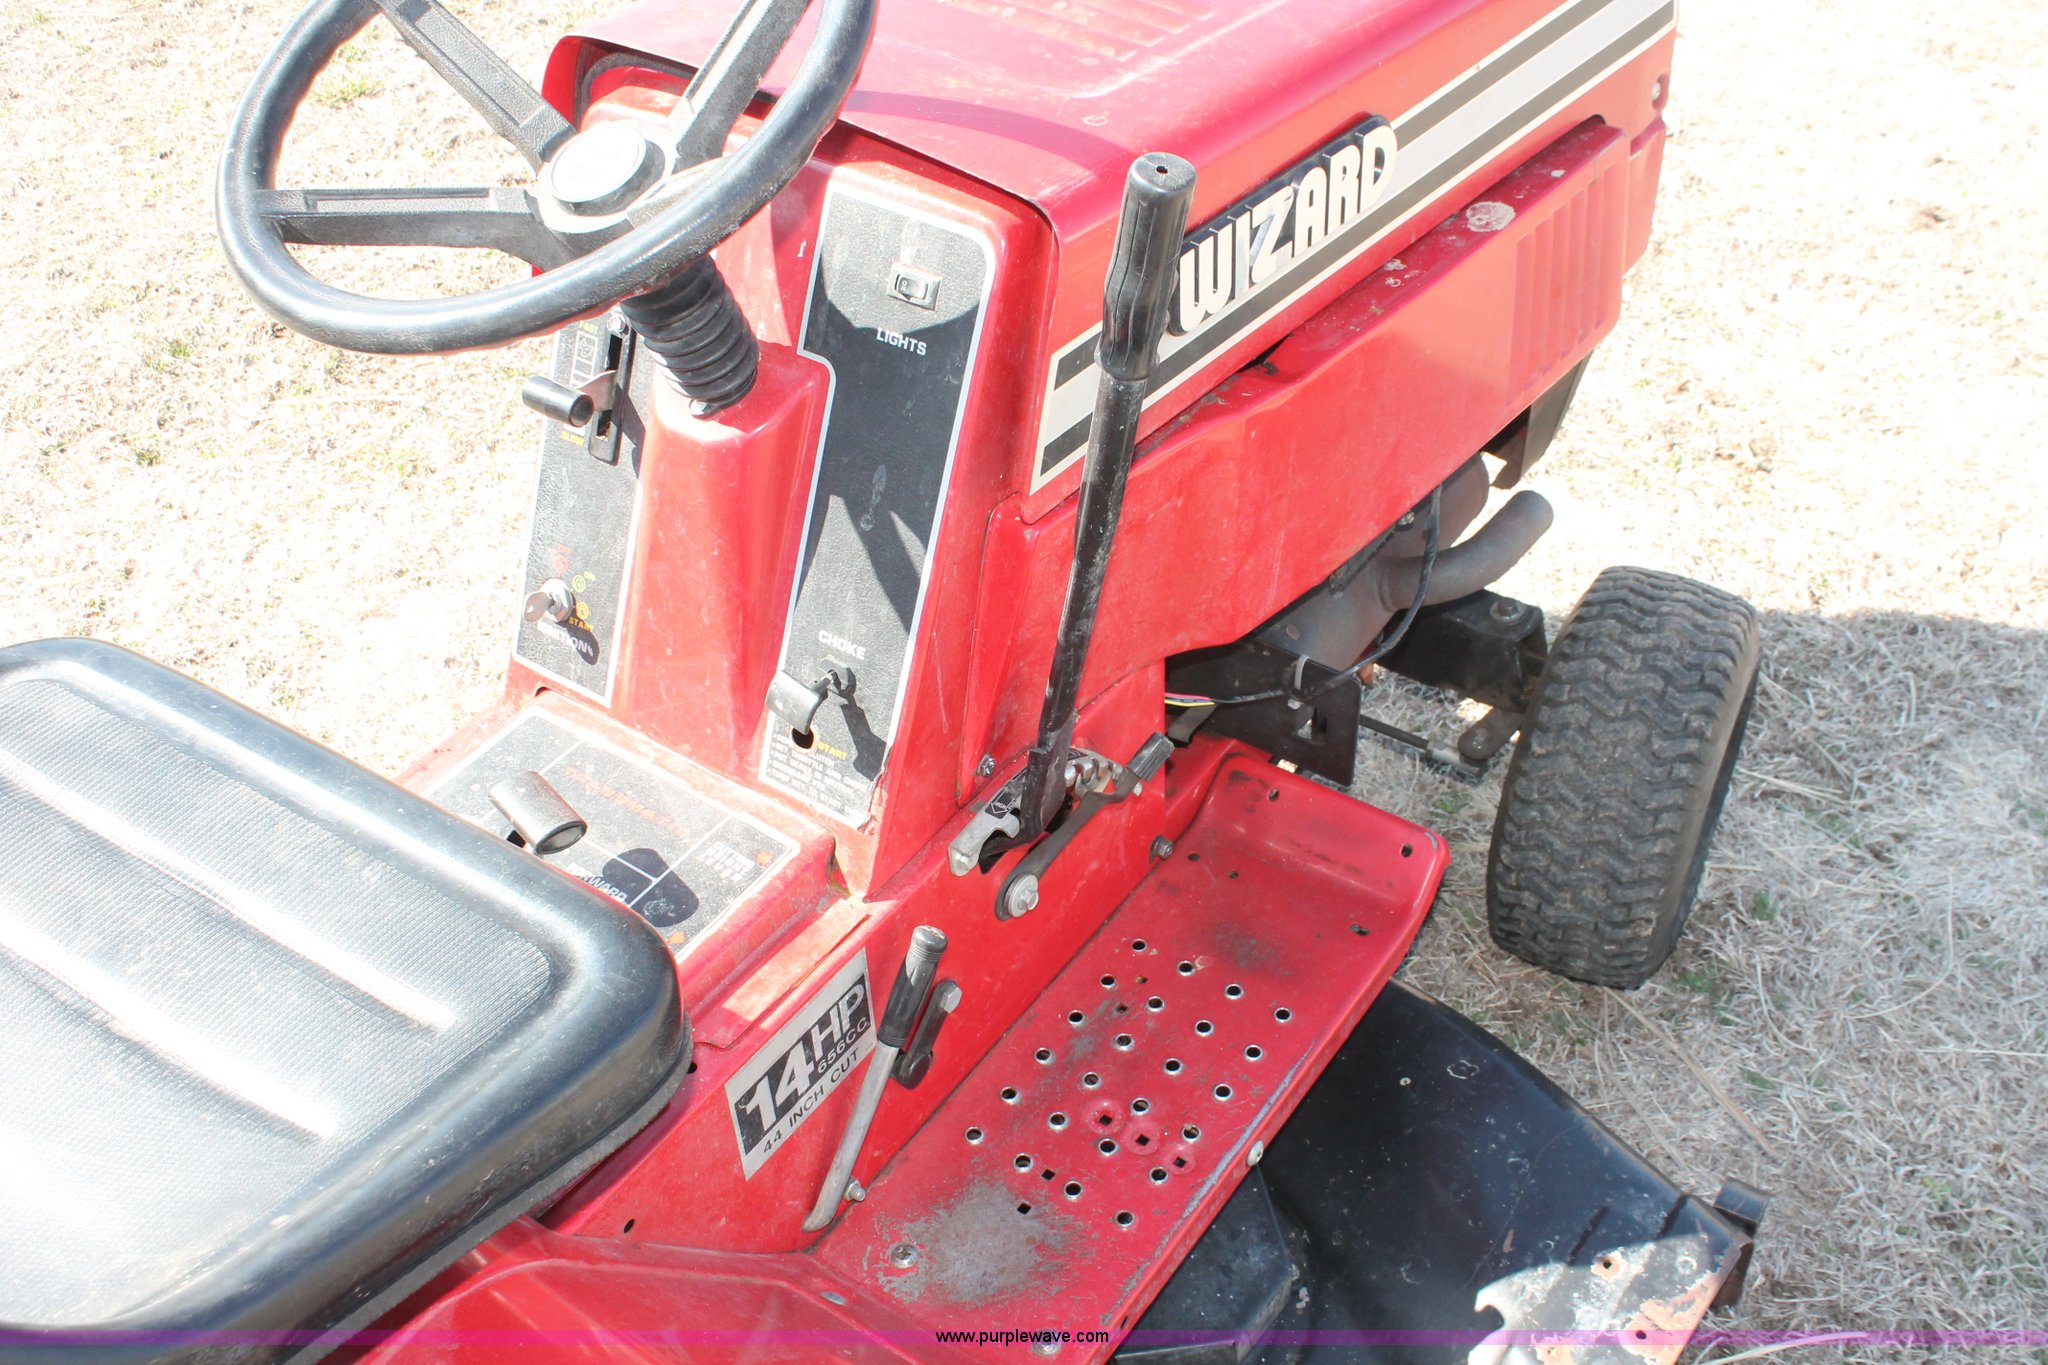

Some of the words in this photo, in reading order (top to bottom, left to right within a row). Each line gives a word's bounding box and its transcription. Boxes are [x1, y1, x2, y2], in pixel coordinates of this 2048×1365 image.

[1178, 125, 1398, 333] WIZARD
[579, 320, 599, 334] FAST
[876, 327, 928, 356] LIGHTS
[561, 431, 585, 447] SLOW
[537, 620, 587, 652] IGNITION
[568, 616, 594, 632] START
[818, 629, 866, 660] CHOKE
[817, 741, 848, 760] START
[818, 1017, 870, 1073] 656CC
[764, 1130, 782, 1154] 44
[789, 1086, 824, 1127] INCH
[830, 1050, 859, 1084] CUT
